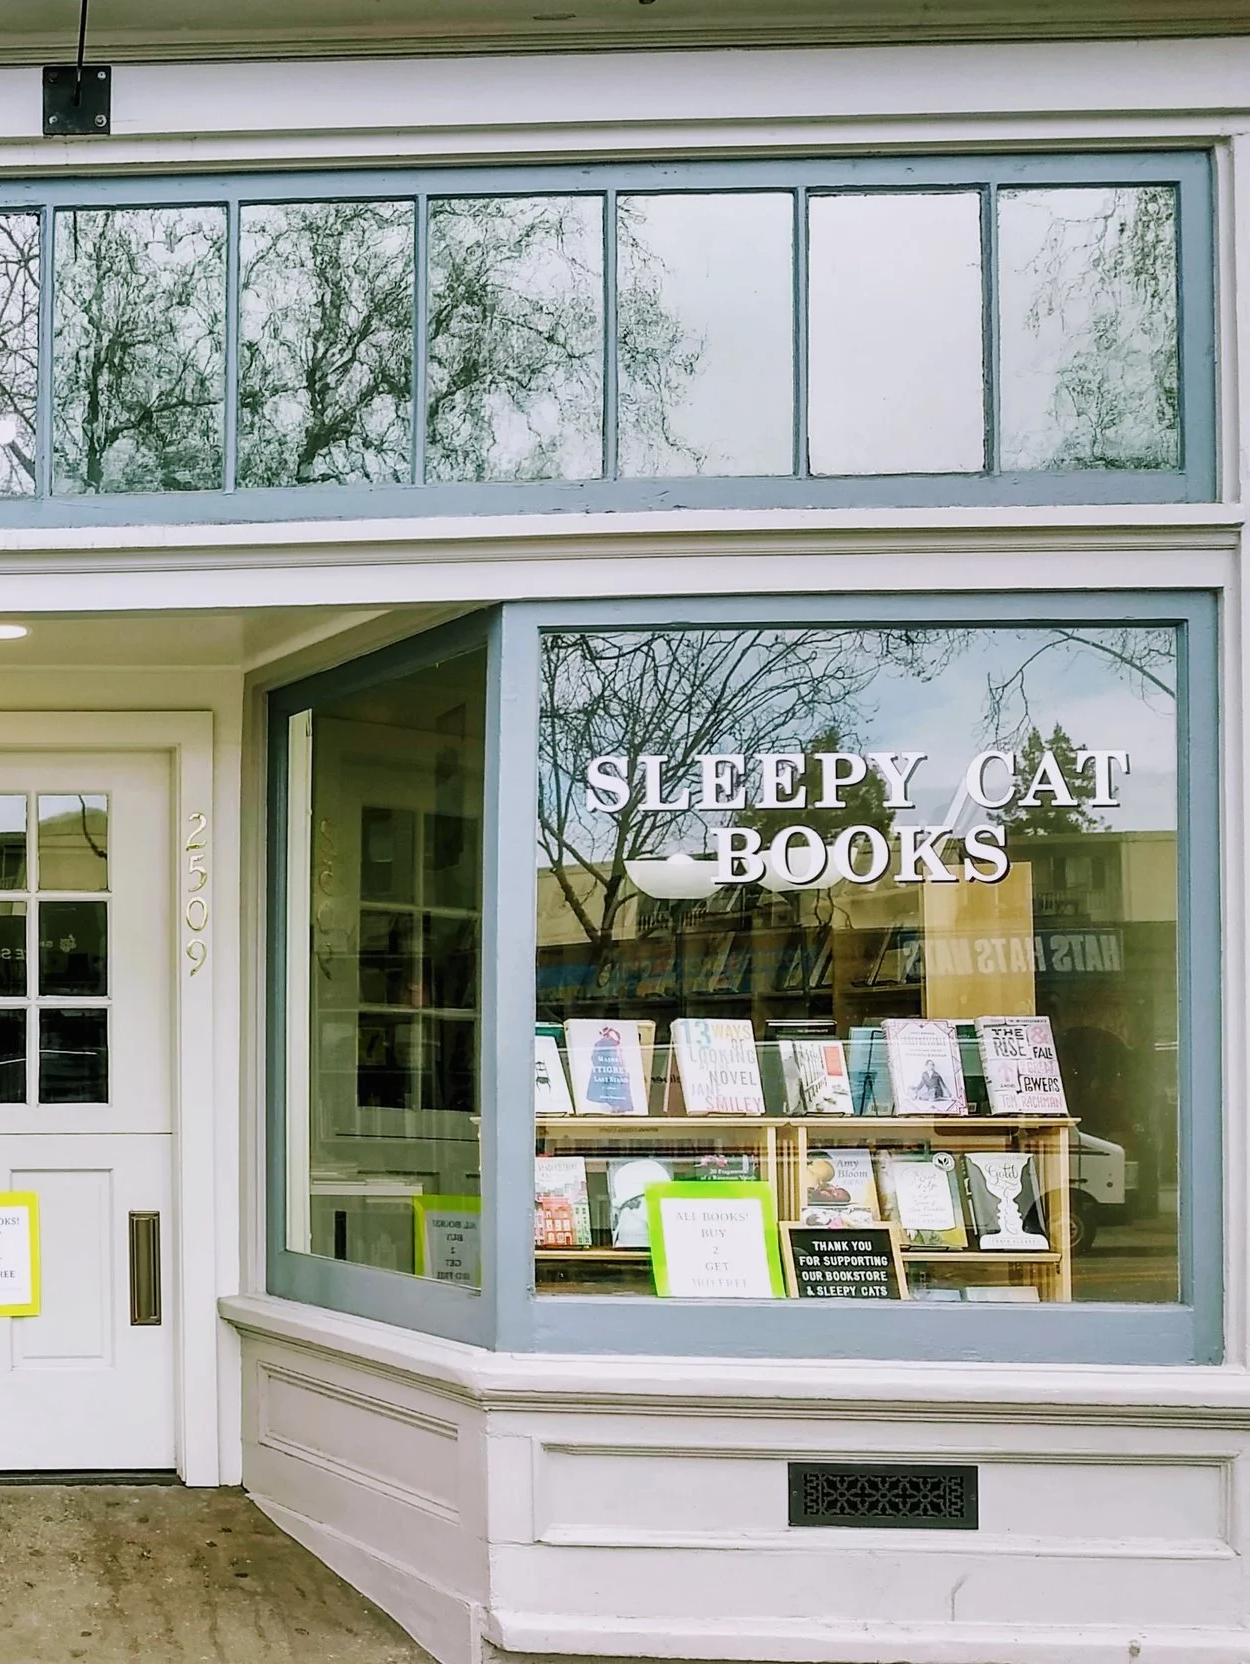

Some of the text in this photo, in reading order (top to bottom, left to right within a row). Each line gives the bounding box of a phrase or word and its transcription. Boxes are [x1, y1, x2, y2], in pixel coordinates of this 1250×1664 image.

[586, 750, 1131, 812] SLEEPY CAT
[710, 824, 1011, 885] BOOKS
[186, 812, 208, 977] 2509
[712, 1023, 751, 1039] WAYS
[991, 1028, 1023, 1037] THE
[993, 1037, 1027, 1057] RISE
[1033, 1046, 1053, 1059] FALL
[709, 1070, 757, 1086] NOVEL
[706, 1096, 761, 1112] SMILEY
[837, 1160, 858, 1170] Amy
[838, 1170, 868, 1178] Bloom
[677, 1212, 695, 1221] ALL
[702, 1229, 726, 1238] BUY
[713, 1246, 719, 1255] 2
[812, 1241, 872, 1251] THANK YOU
[799, 1256, 888, 1266] FOR SUPPORTING
[705, 1262, 729, 1271] GET
[802, 1271, 888, 1281] OUR BOOKSTORE
[806, 1286, 888, 1296] & SLEEPY CATS
